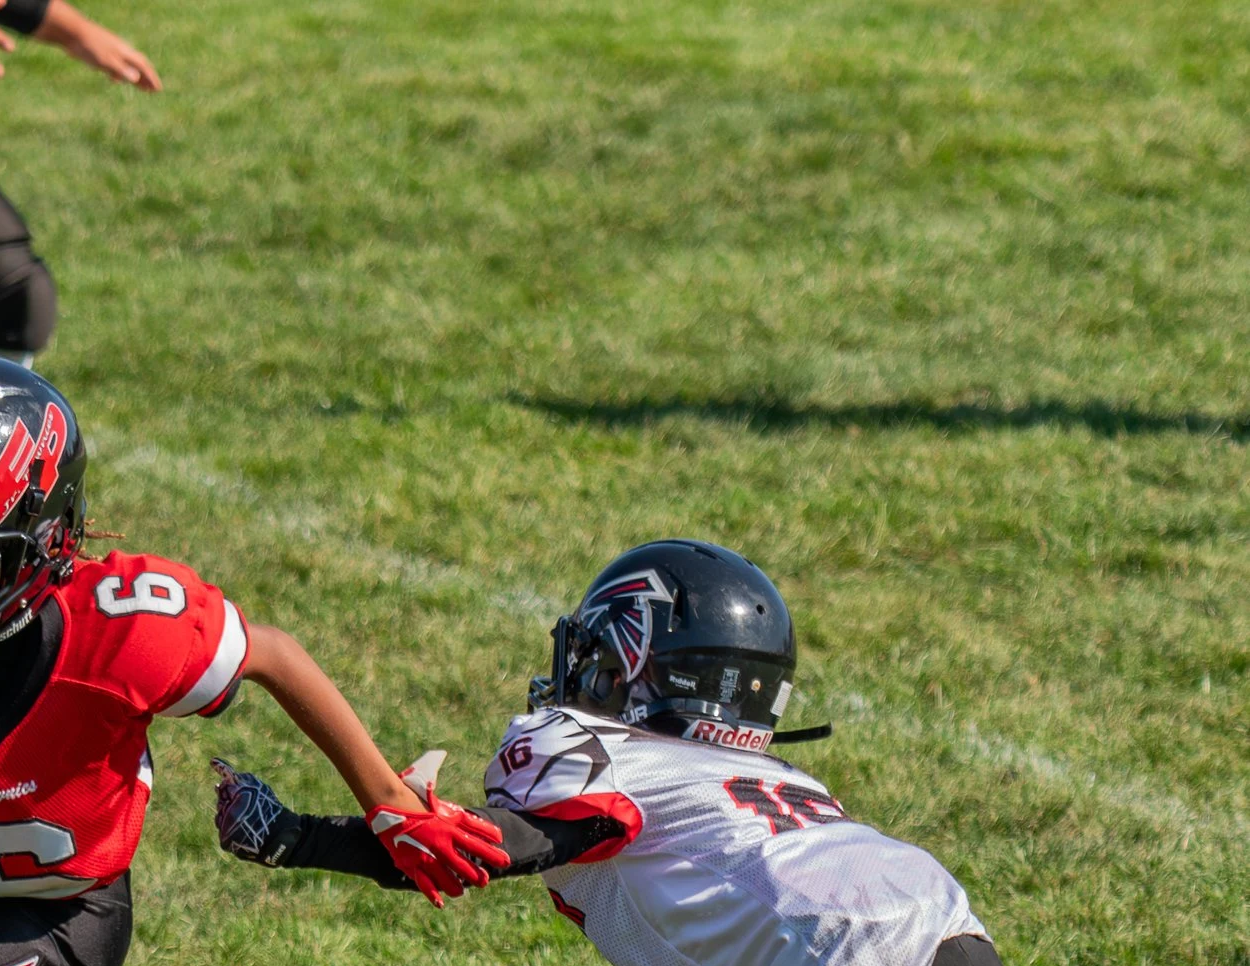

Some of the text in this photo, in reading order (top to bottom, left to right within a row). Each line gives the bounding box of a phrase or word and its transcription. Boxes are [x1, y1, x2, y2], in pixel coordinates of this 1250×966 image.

[93, 571, 188, 619] 6
[498, 735, 535, 778] 16
[691, 721, 772, 751] Riddell
